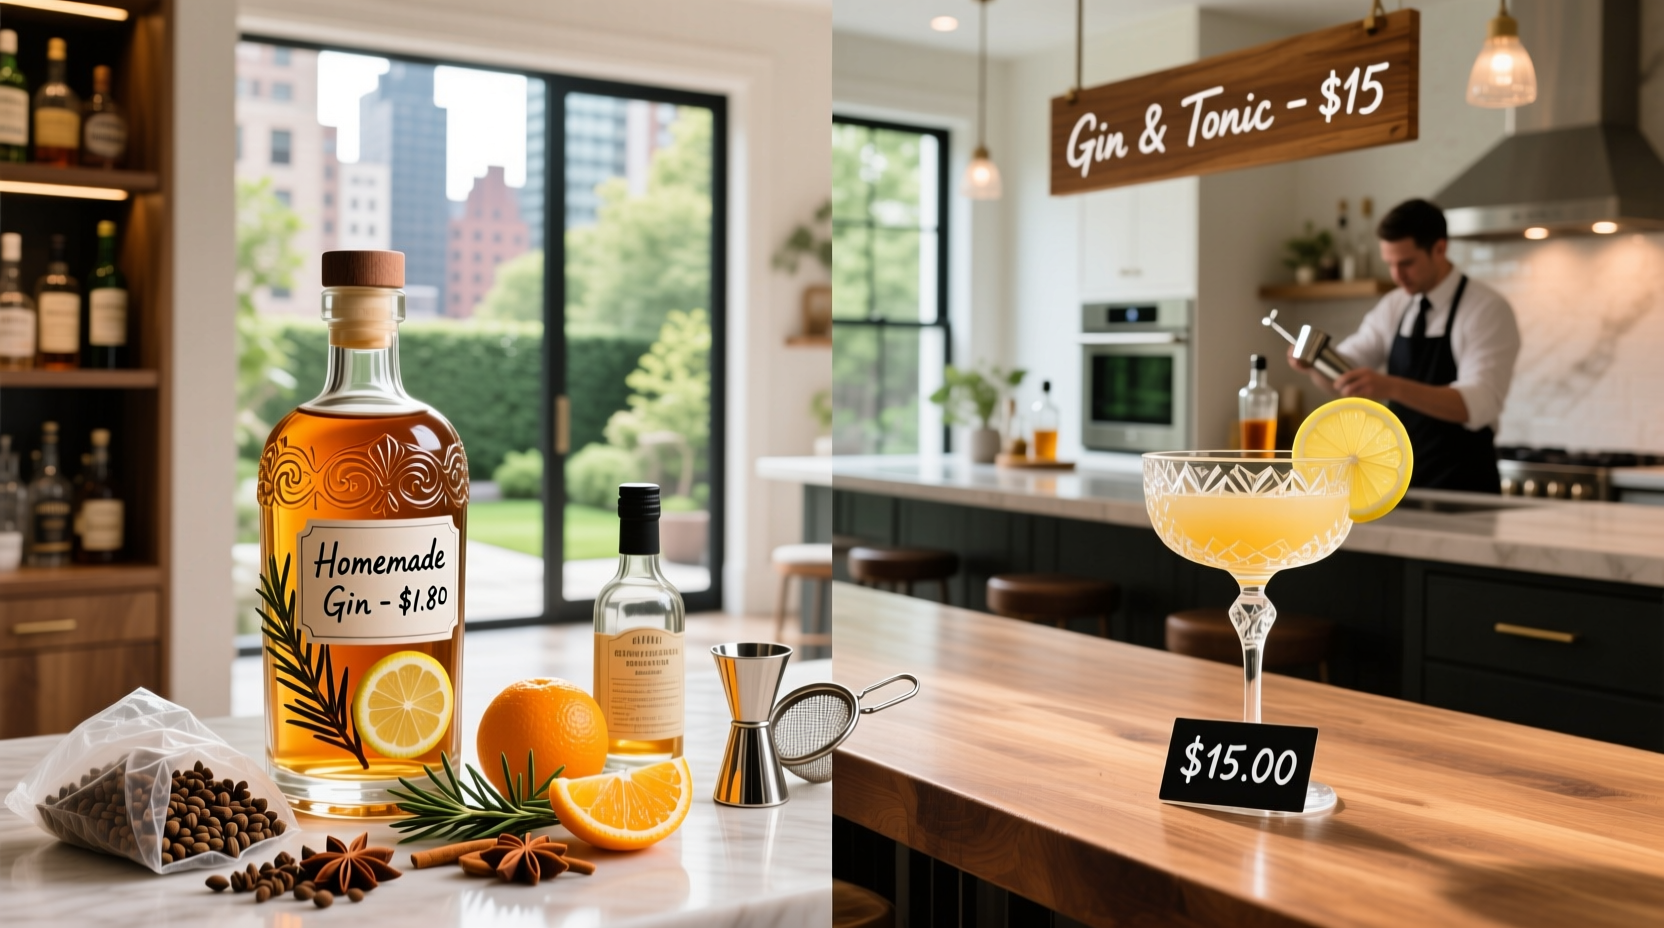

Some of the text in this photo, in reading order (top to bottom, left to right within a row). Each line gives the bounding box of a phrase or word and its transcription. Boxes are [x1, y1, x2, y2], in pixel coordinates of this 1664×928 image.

[1066, 112, 1128, 177] Gin
[1138, 103, 1168, 154] &
[1181, 85, 1275, 147] Tonic
[1318, 62, 1390, 124] $15
[313, 537, 446, 578] Homemade
[323, 585, 372, 623] Gin
[398, 585, 448, 616] $1.80
[1179, 734, 1298, 786] $15.00
